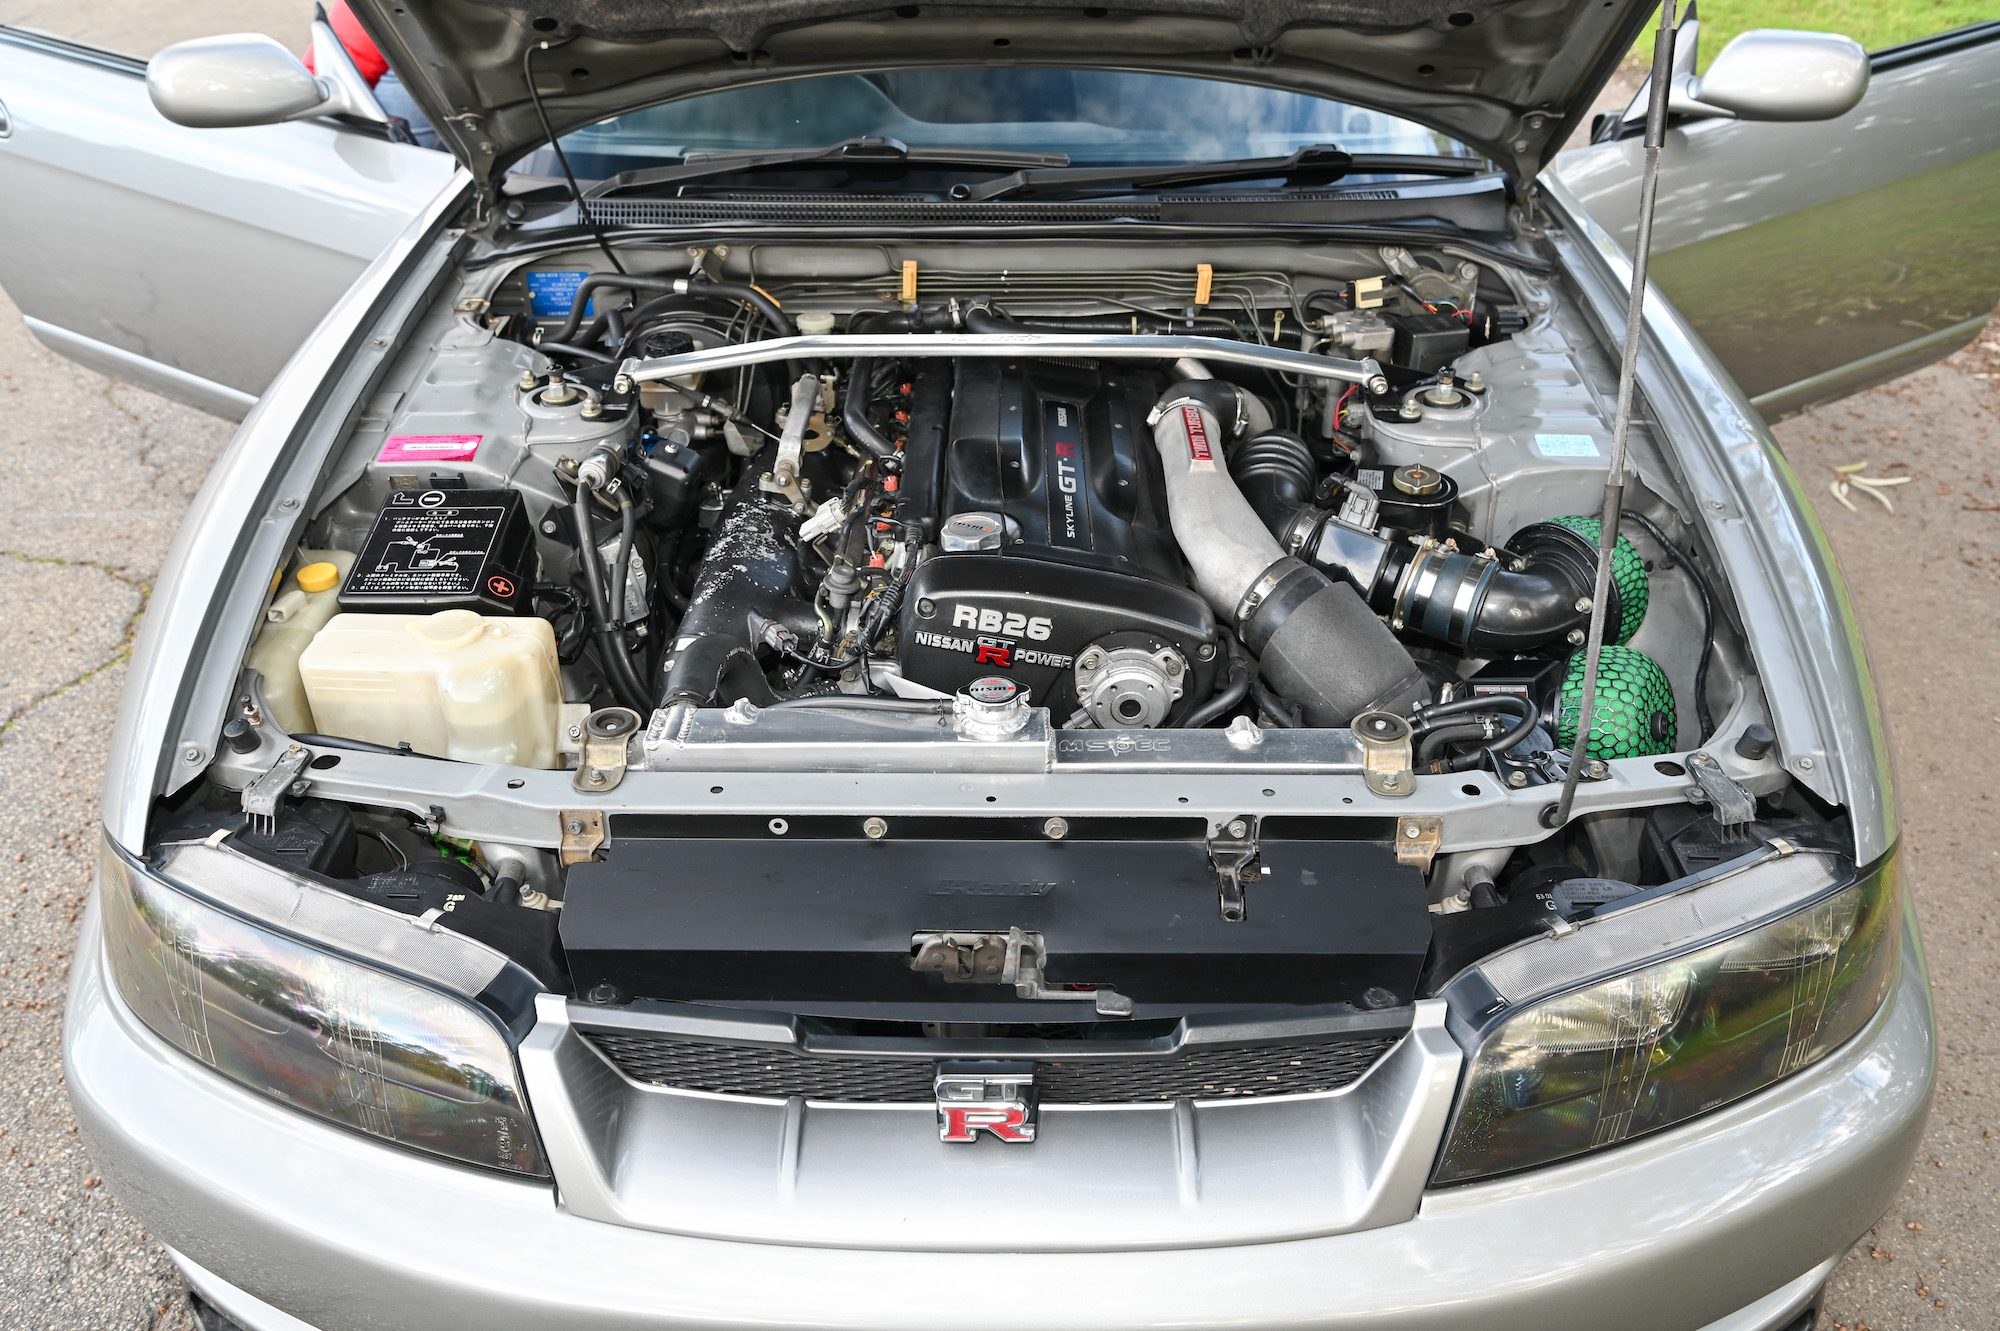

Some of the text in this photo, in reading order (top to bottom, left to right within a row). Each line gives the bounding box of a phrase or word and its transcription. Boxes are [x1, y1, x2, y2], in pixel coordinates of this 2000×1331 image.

[1185, 406, 1210, 458] TWIN TURBO
[1064, 494, 1076, 539] SKYLINE
[952, 604, 1054, 642] RB26
[914, 631, 975, 654] NISSAN
[1013, 648, 1075, 670] POWER
